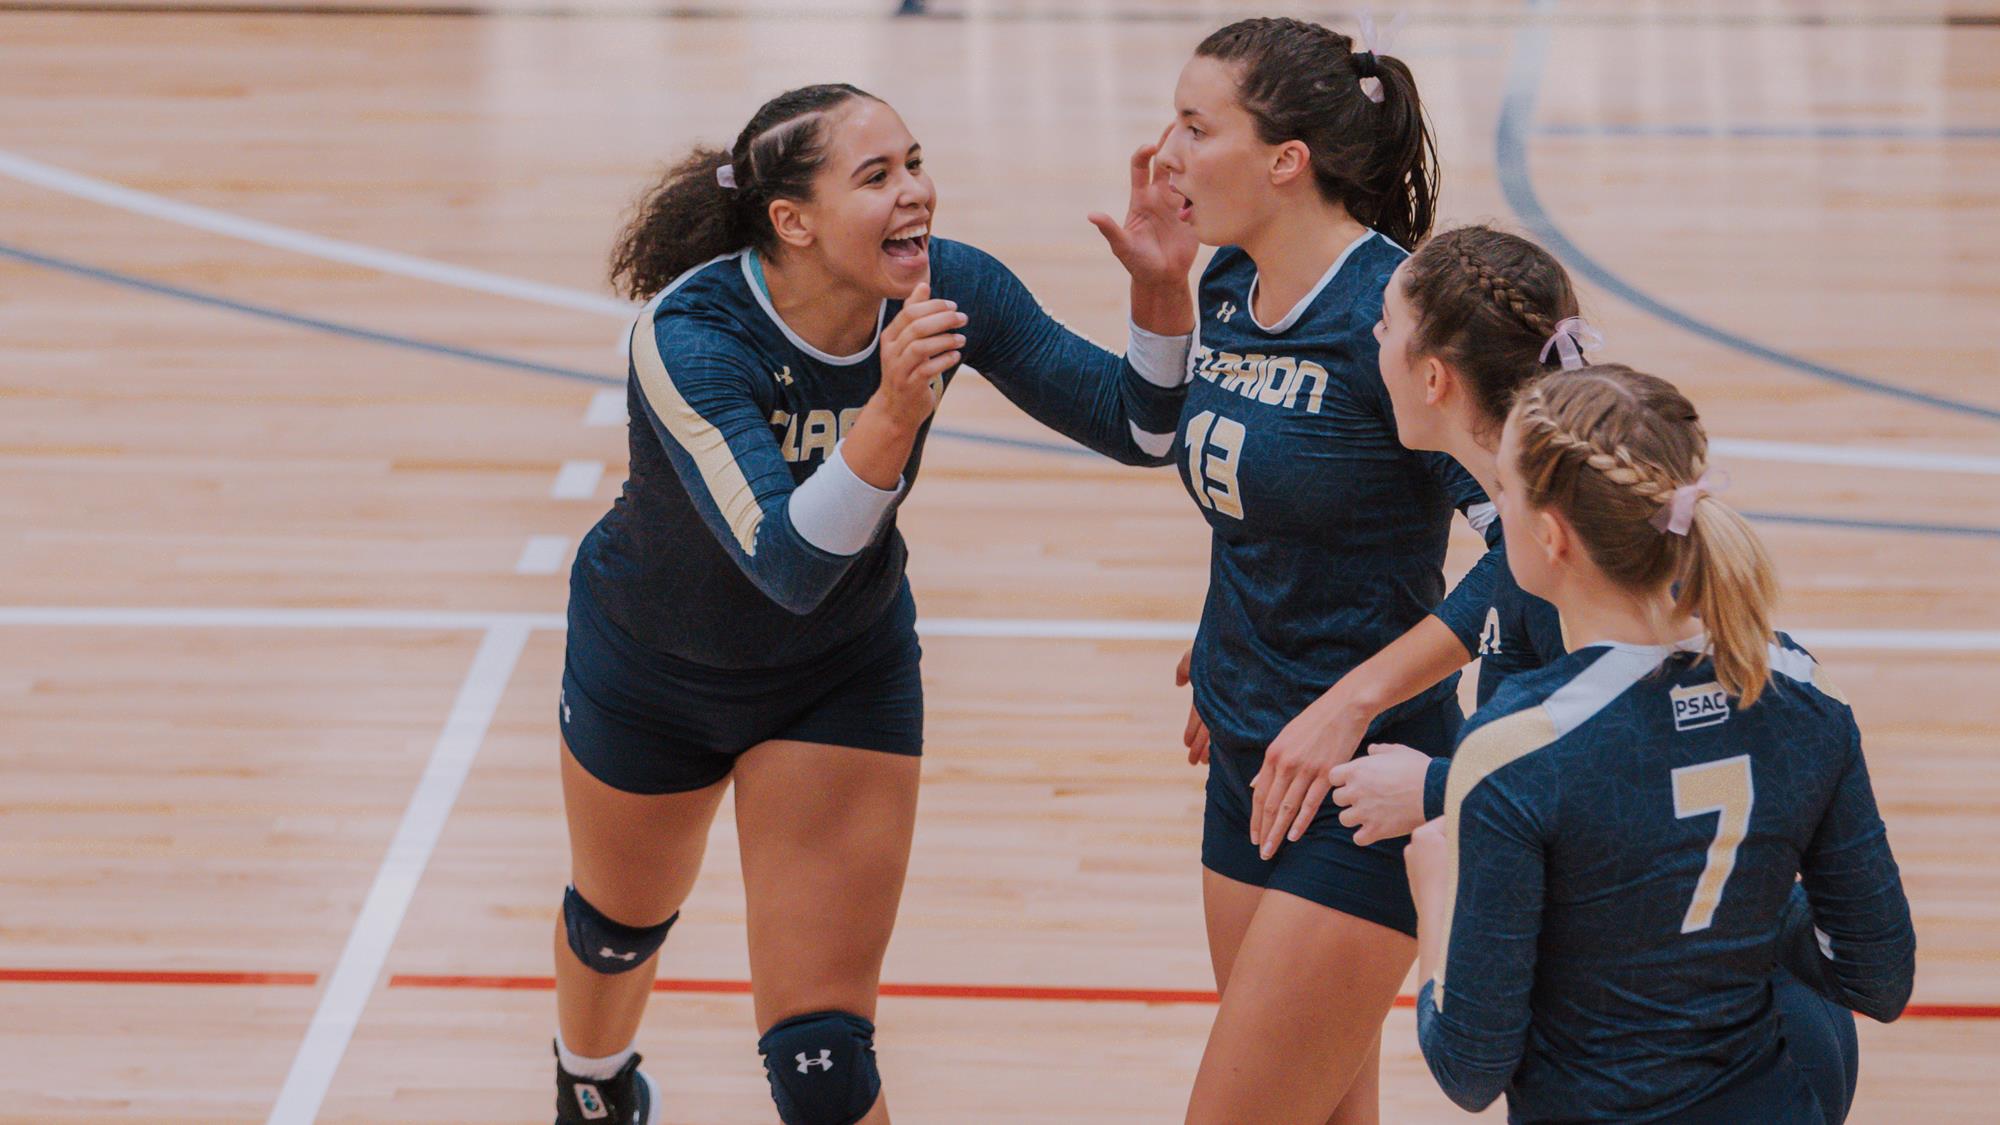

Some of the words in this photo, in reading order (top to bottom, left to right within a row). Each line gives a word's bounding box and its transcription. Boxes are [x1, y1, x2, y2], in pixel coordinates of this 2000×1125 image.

[1185, 410, 1246, 520] 13
[1675, 691, 1726, 717] PSAC
[1671, 754, 1754, 934] 7
